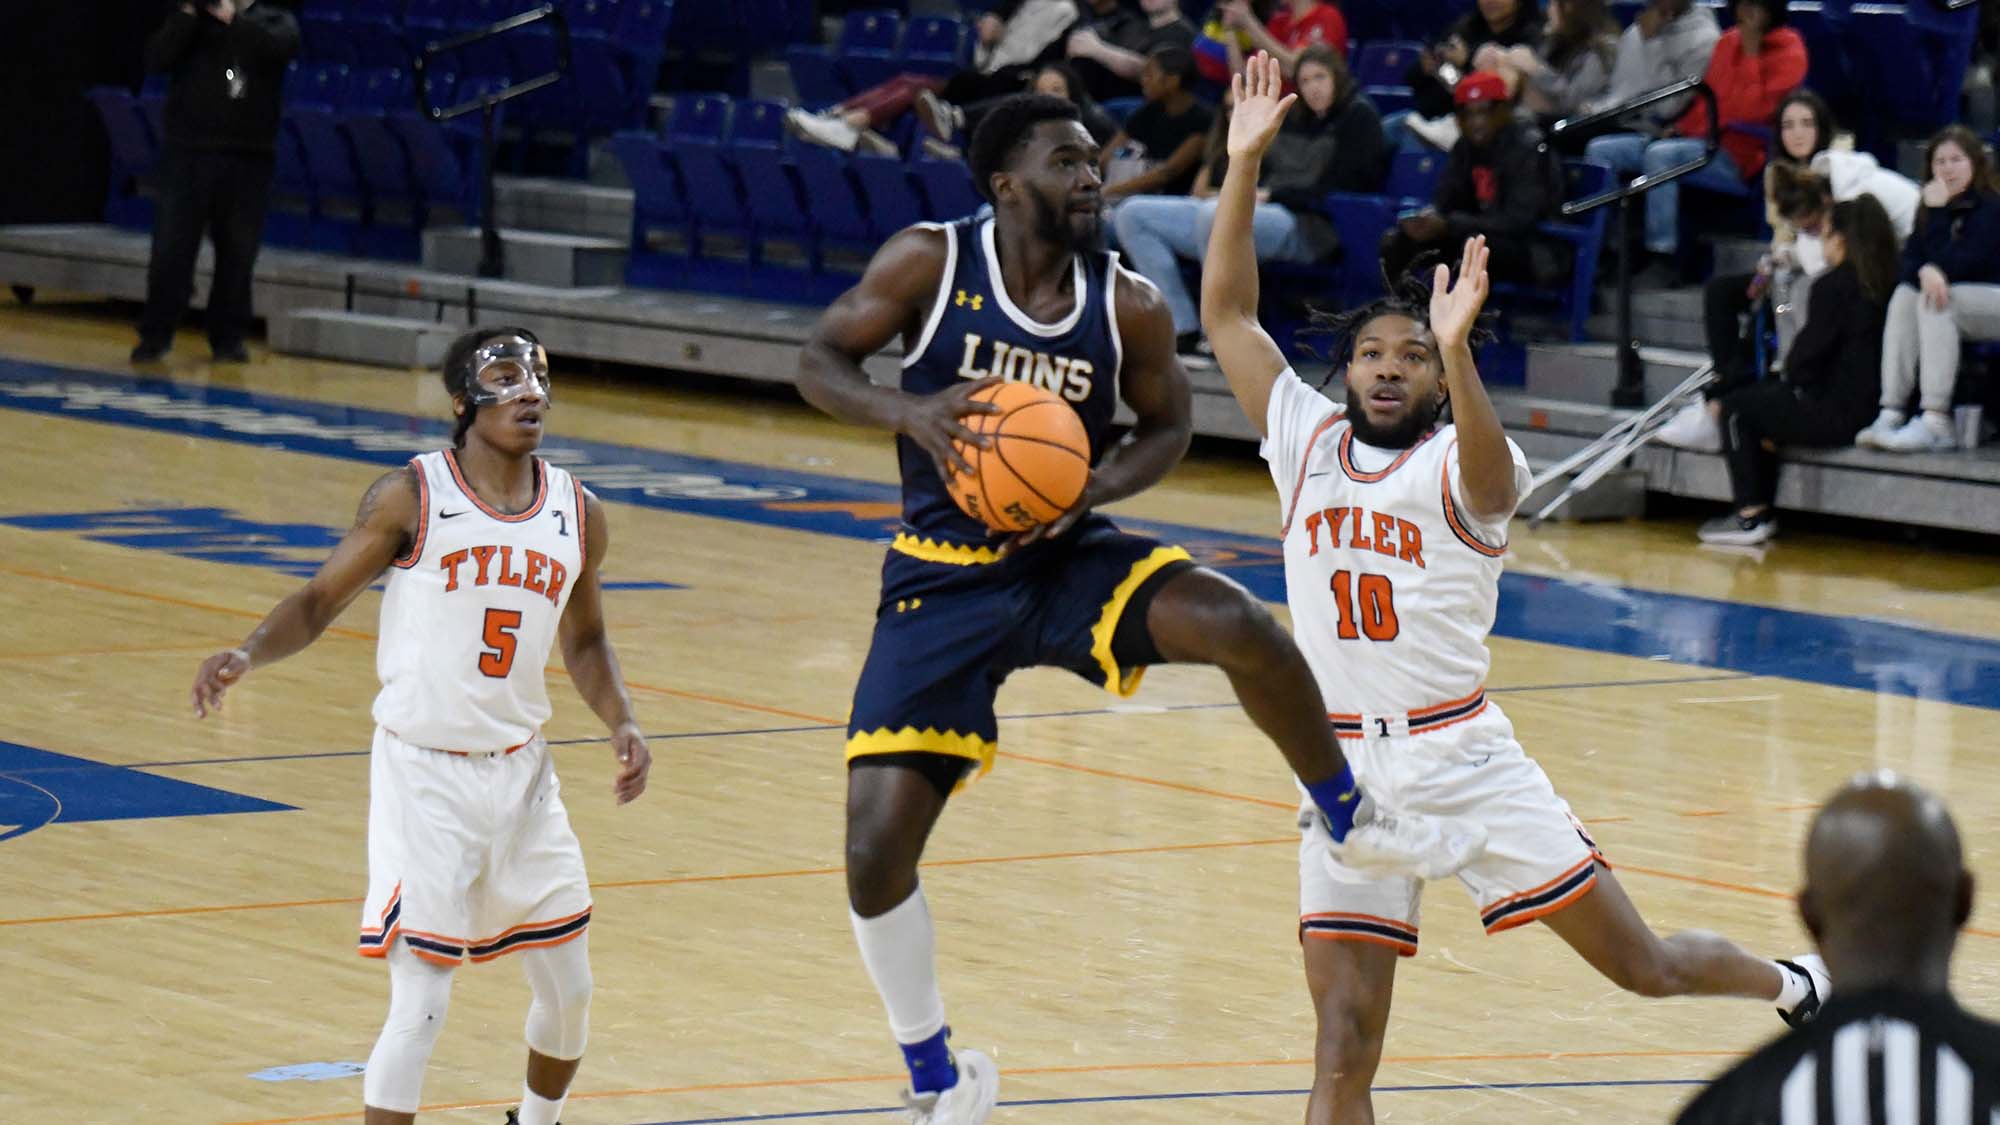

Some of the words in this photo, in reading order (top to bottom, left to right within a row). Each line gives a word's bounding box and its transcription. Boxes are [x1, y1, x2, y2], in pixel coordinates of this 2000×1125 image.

[958, 333, 1093, 402] LIONS
[1304, 507, 1426, 569] TYLER
[440, 545, 567, 608] TYLER
[1330, 569, 1400, 641] 10
[478, 607, 522, 679] 5
